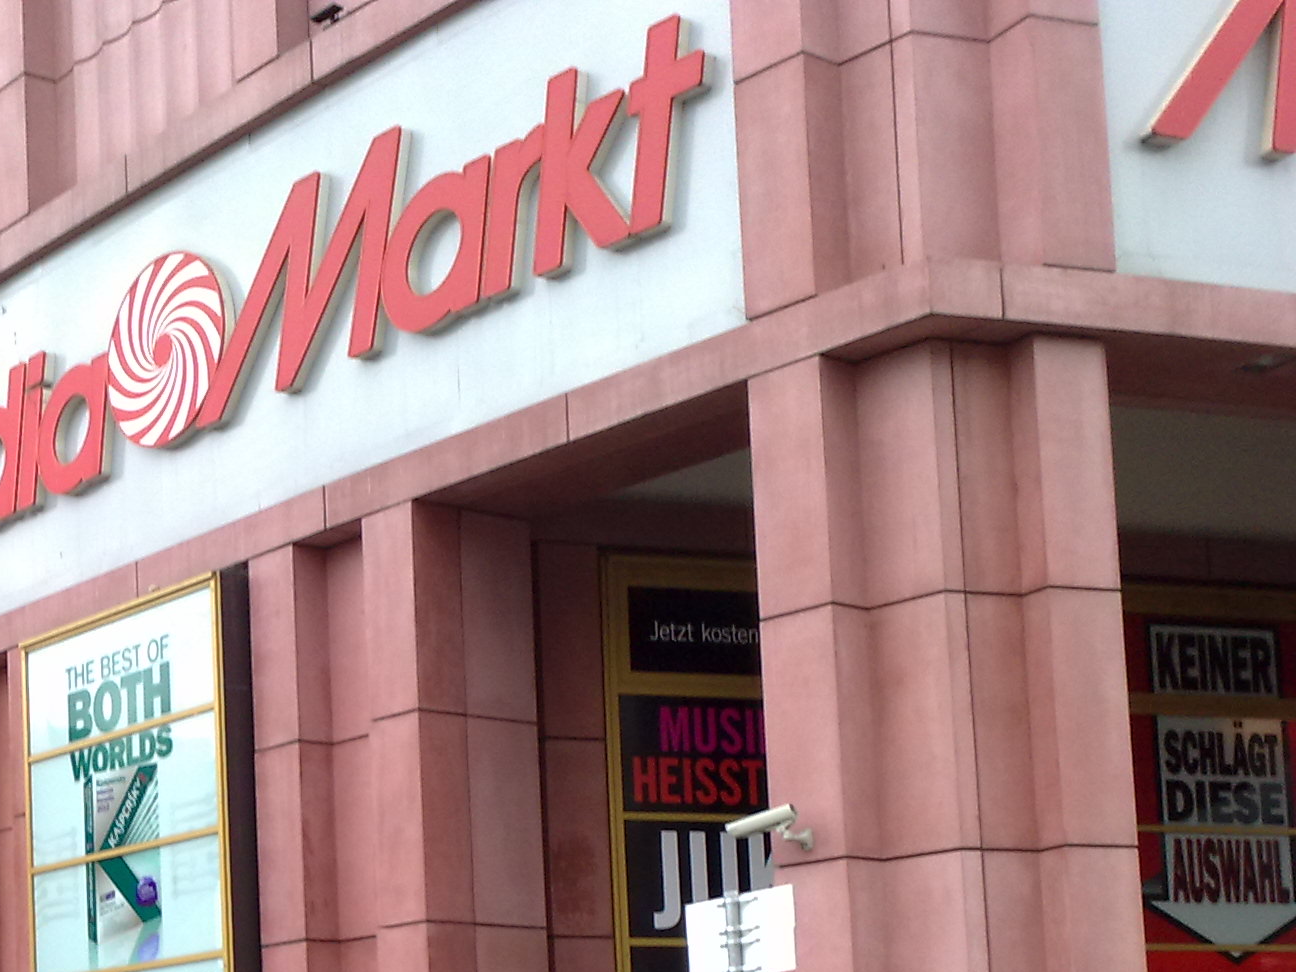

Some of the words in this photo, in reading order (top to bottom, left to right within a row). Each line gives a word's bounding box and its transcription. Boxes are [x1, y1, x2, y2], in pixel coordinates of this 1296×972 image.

[197, 13, 715, 428] Markt
[650, 620, 694, 642] Jetzt
[65, 660, 95, 690] THE
[100, 644, 141, 680] BEST
[147, 634, 169, 662] OF
[1155, 632, 1275, 693] KEINER
[67, 661, 171, 742] BOTH
[70, 724, 173, 781] WORLDS
[659, 706, 765, 754] MUSI
[1164, 721, 1278, 777] SCHLÄGT
[632, 756, 764, 806] HEISST
[1165, 779, 1285, 825] DIESE
[1172, 837, 1290, 904] AUSWAHL
